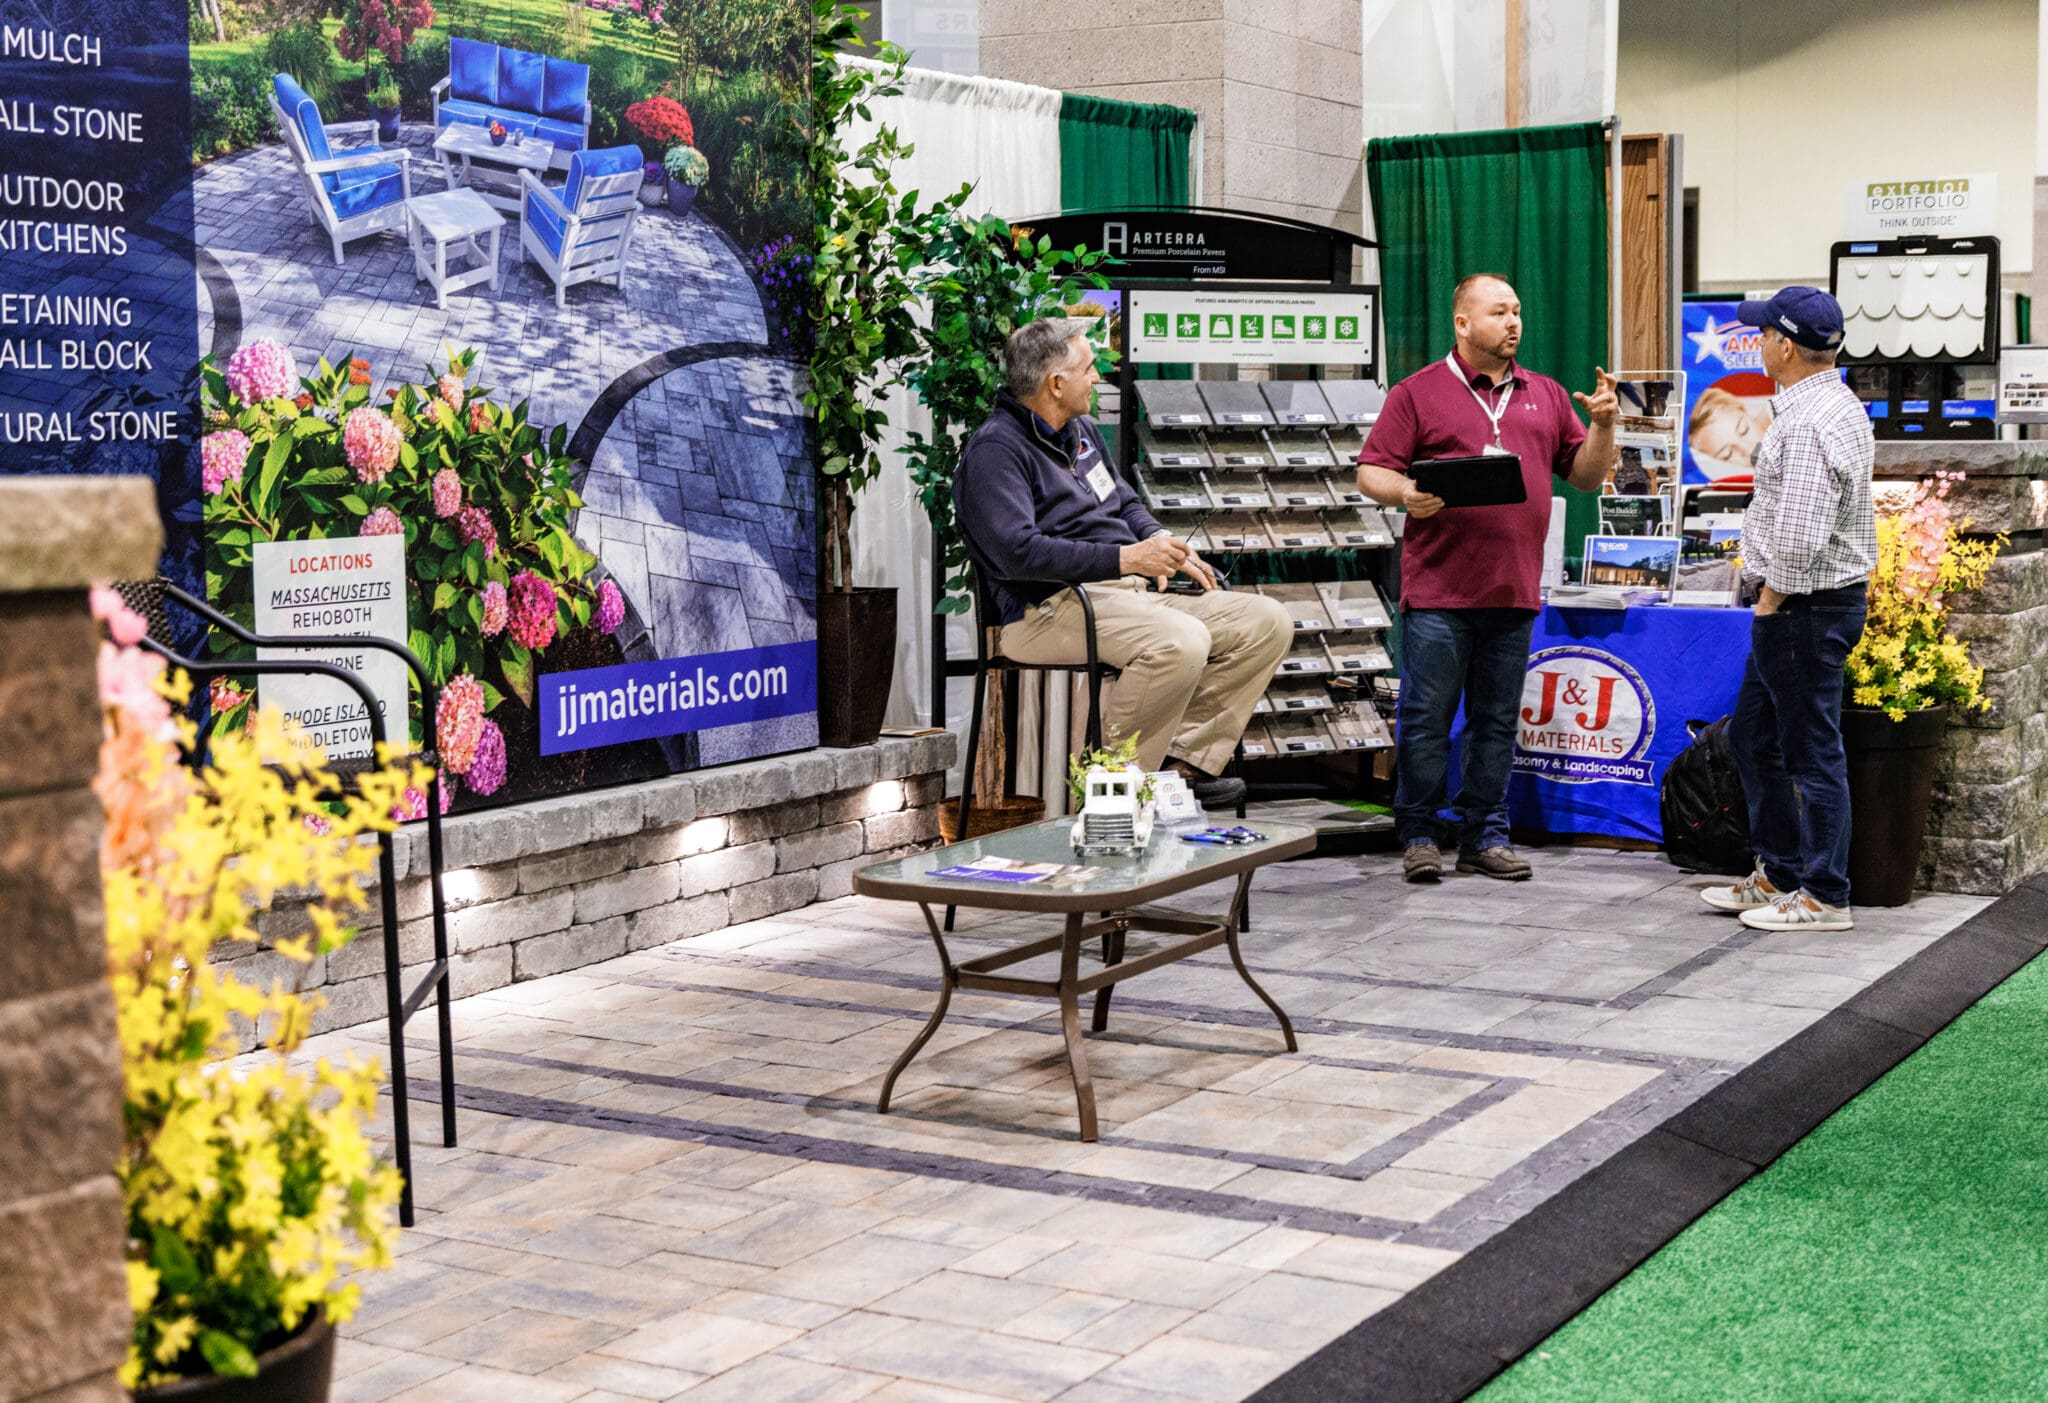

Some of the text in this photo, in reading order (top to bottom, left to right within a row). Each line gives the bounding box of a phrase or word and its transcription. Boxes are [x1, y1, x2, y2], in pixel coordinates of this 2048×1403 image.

[3, 25, 102, 67] MULCH
[52, 104, 144, 143] STONE
[0, 175, 125, 213] UTDOOR
[1872, 181, 1967, 198] exterior
[1871, 194, 1966, 212] PORTFOLIO
[1879, 218, 1908, 229] THINK
[1133, 231, 1206, 246] ARTERRA
[1132, 247, 1226, 257] Premium Porcelain Pavers
[1192, 265, 1227, 275] From MSI
[60, 338, 153, 372] BLOCK
[0, 410, 179, 444] URAL STONE
[289, 553, 373, 575] LOCATIONS
[270, 581, 392, 608] MASSACHUSETTS
[293, 607, 373, 629] REHOBOTH
[557, 664, 788, 737] jjmaterials.com
[1522, 672, 1623, 730] J&J
[1522, 730, 1623, 754] MATERIALS
[1512, 755, 1644, 778] asonry & Landscaping
